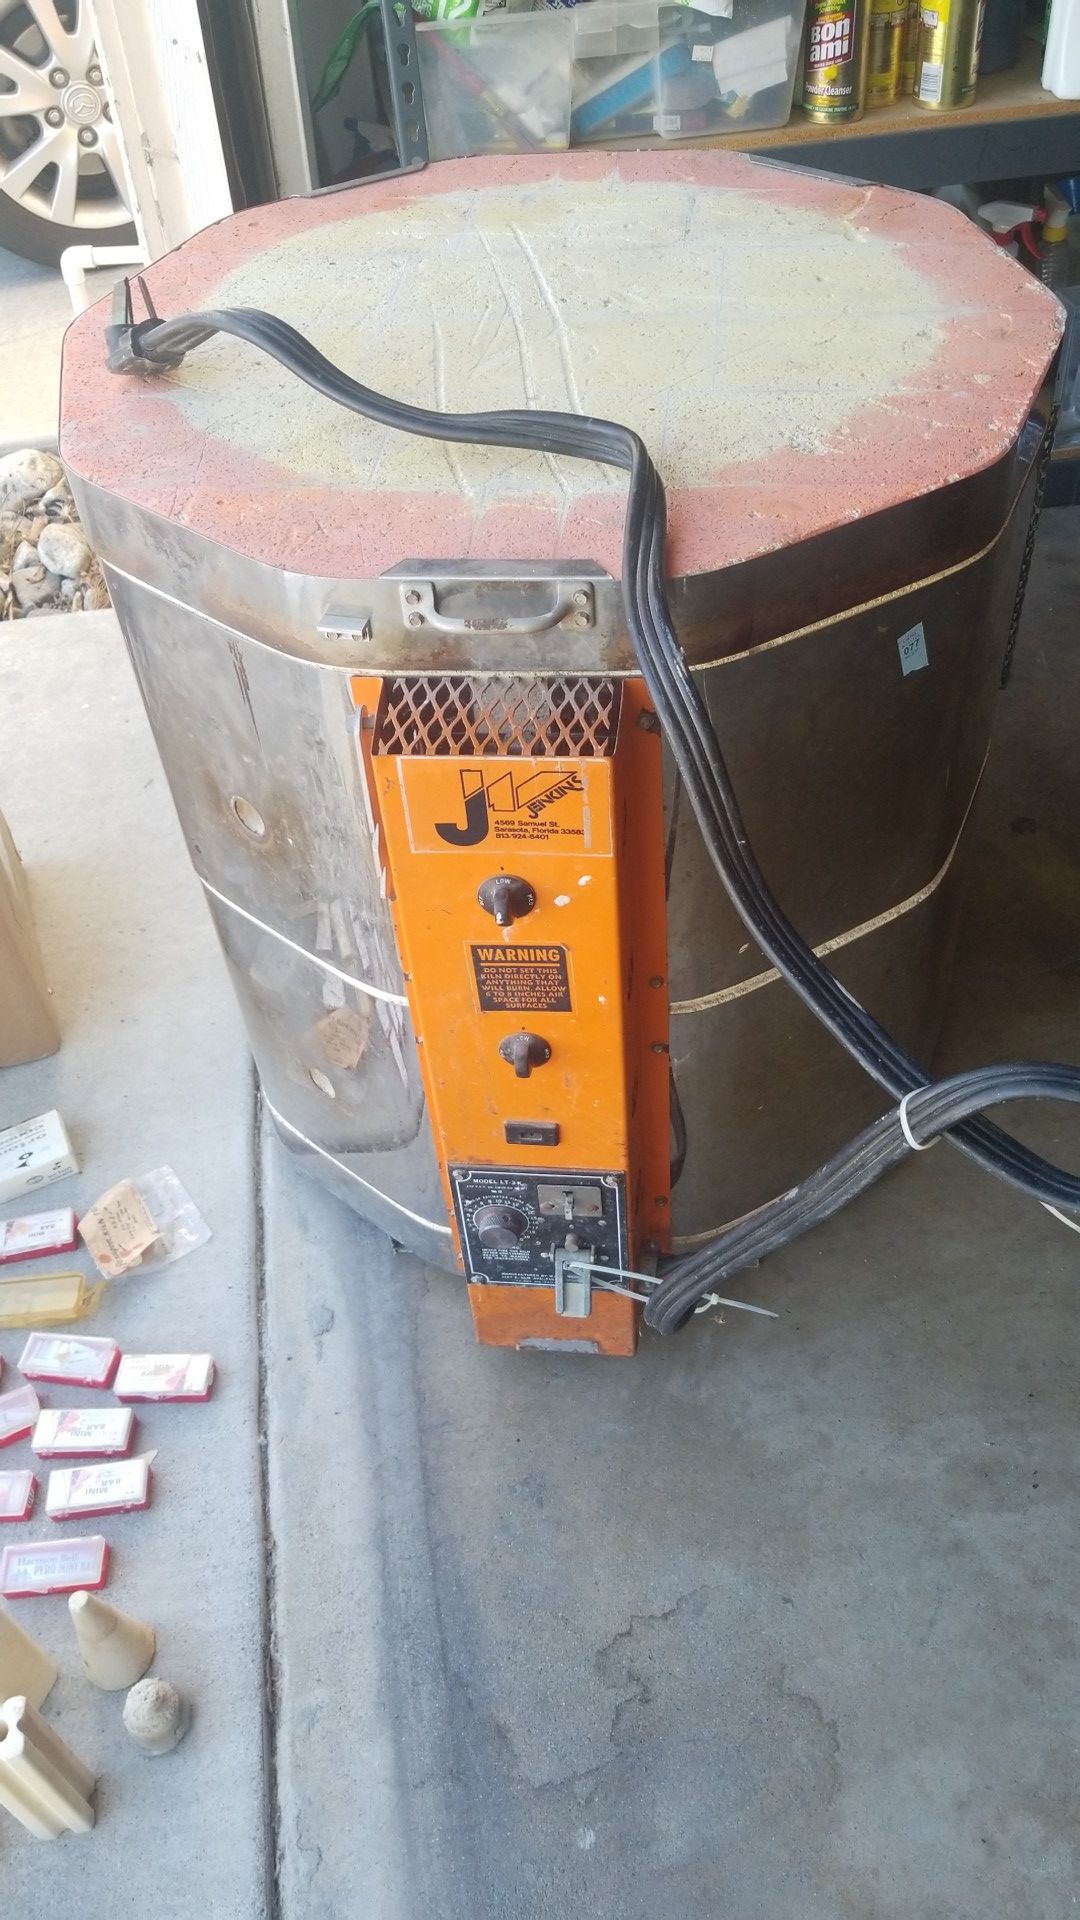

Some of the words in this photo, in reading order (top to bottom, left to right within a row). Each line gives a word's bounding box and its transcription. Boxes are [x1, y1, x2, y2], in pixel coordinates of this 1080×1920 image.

[810, 18, 851, 44] Bon
[809, 35, 850, 62] ami
[824, 85, 853, 97] Cleanser
[526, 775, 585, 819] JENKINS
[494, 826, 531, 834] Sarasota,
[476, 948, 560, 962] WARNING
